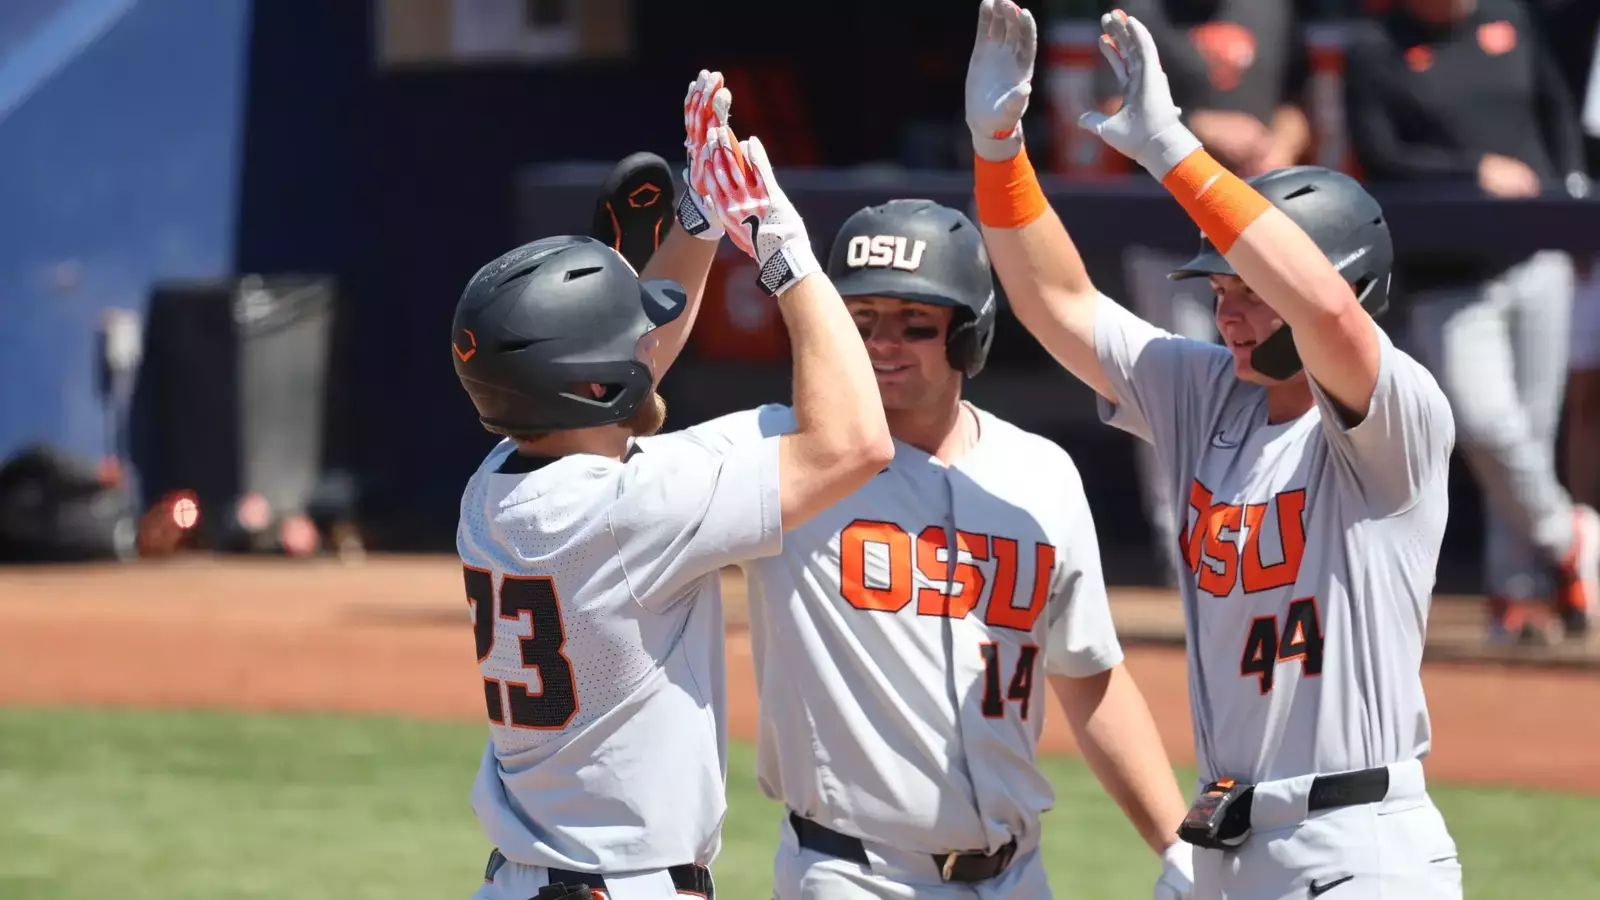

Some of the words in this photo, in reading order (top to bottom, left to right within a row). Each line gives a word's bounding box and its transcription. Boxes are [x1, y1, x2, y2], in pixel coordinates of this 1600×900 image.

[846, 235, 927, 273] OSU
[840, 518, 1056, 632] OSU
[1179, 478, 1307, 597] OSU
[462, 562, 580, 731] 23
[978, 641, 1040, 721] 14
[1240, 596, 1325, 695] 44
